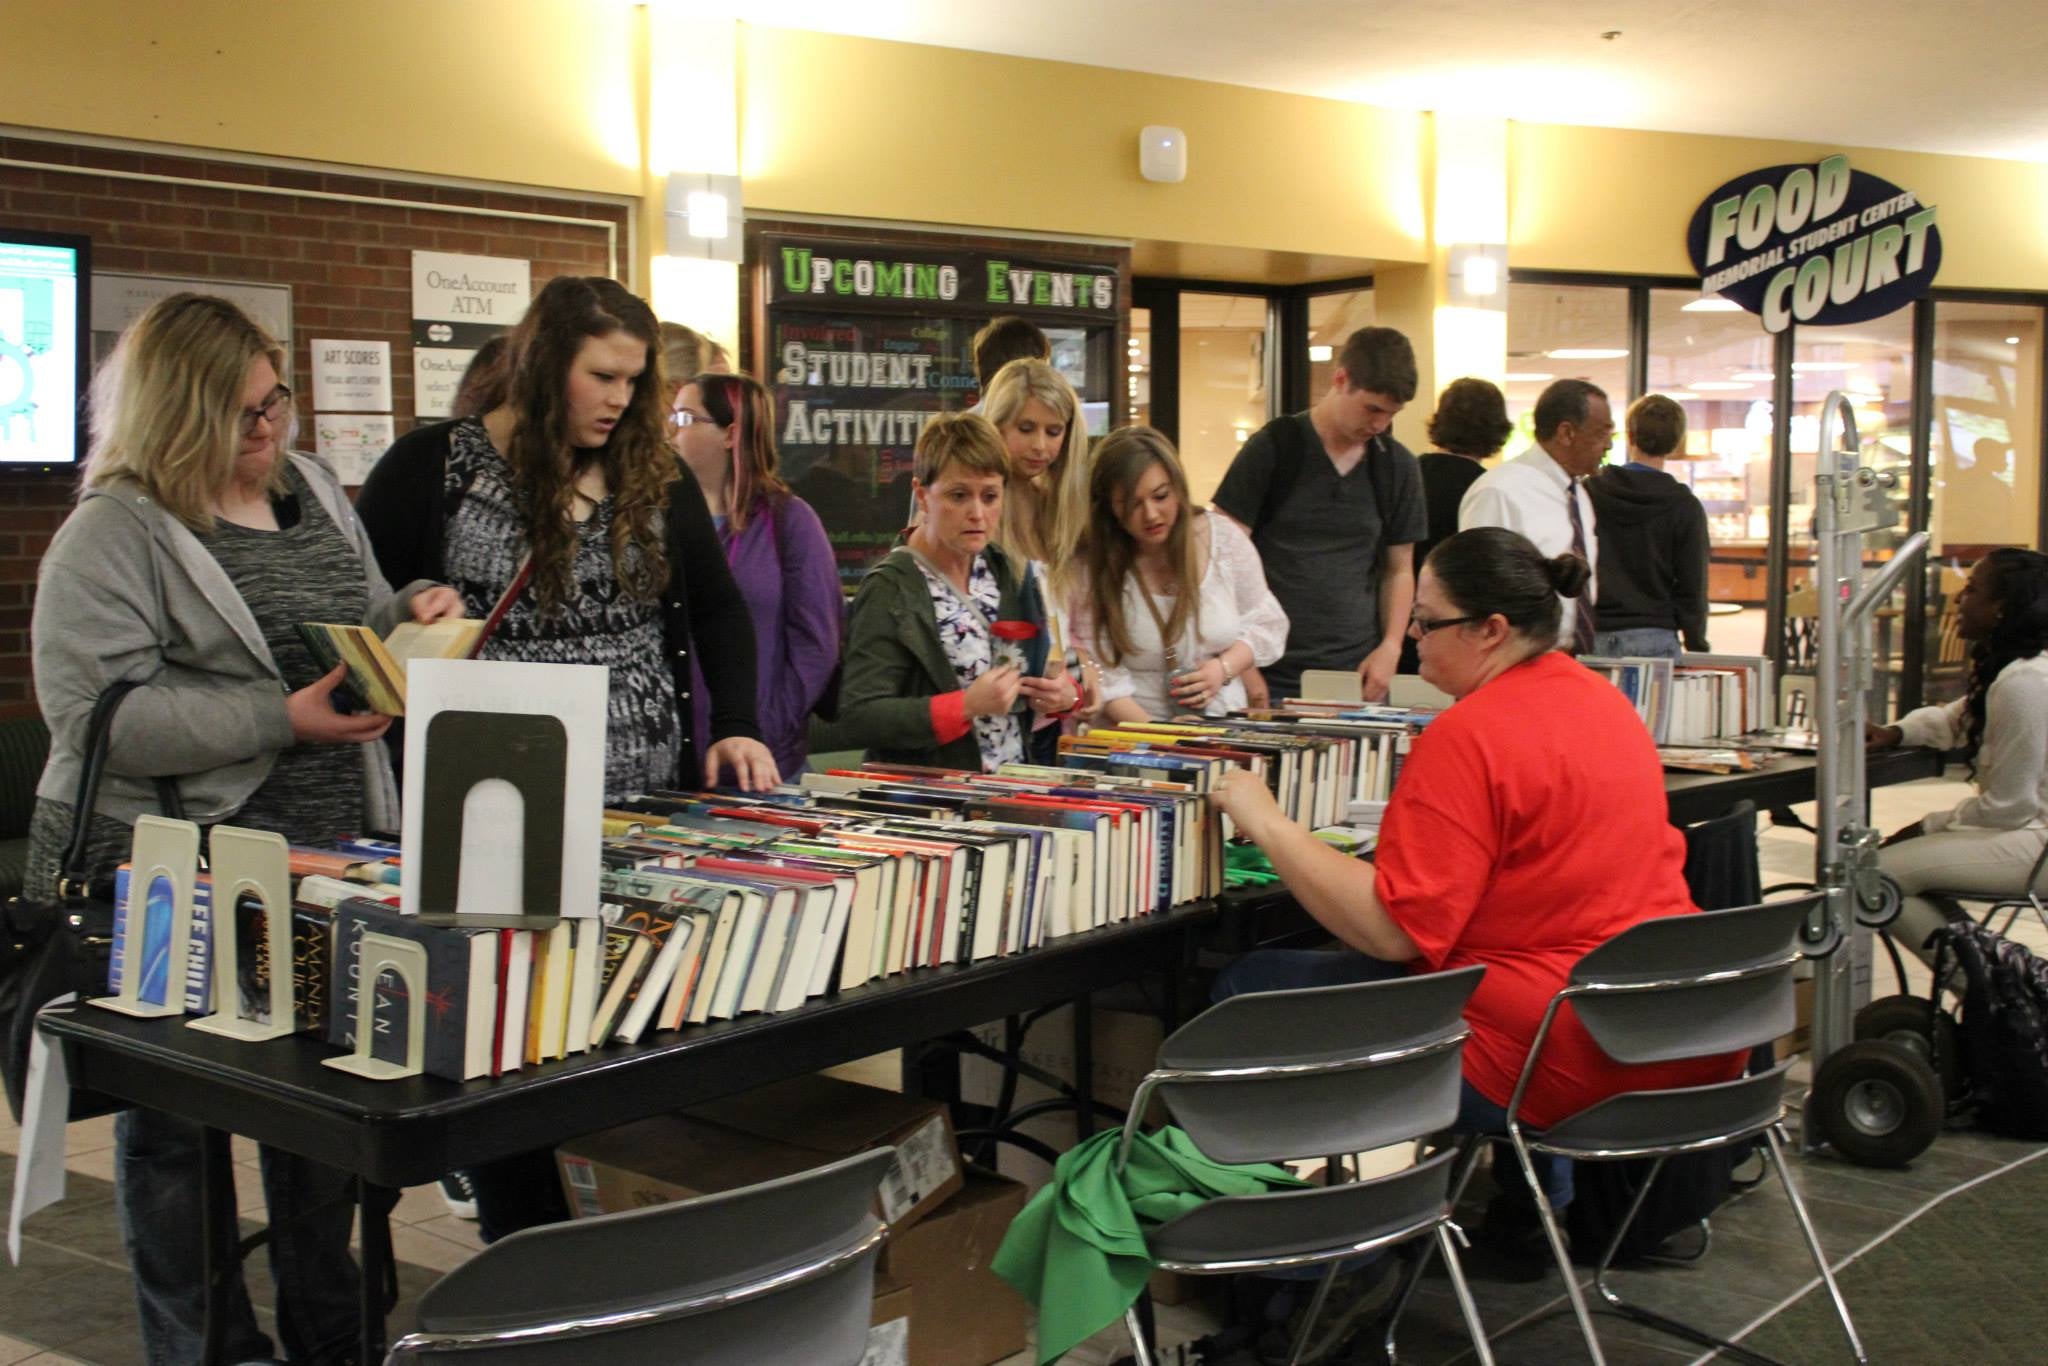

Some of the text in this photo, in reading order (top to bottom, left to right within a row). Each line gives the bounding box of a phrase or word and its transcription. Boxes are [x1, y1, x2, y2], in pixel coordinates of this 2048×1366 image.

[1706, 153, 1851, 268] FOOD
[1702, 191, 1917, 296] MEMORIAL STUDENT CENTER
[1762, 205, 1937, 334] COURT
[426, 270, 518, 295] OneAccount
[451, 296, 493, 315] ATM
[782, 247, 1113, 309] UPCOMING EVENTS
[324, 350, 381, 366] ART SCORES
[782, 341, 932, 389] STUDENT
[307, 923, 326, 1030] AMANDA
